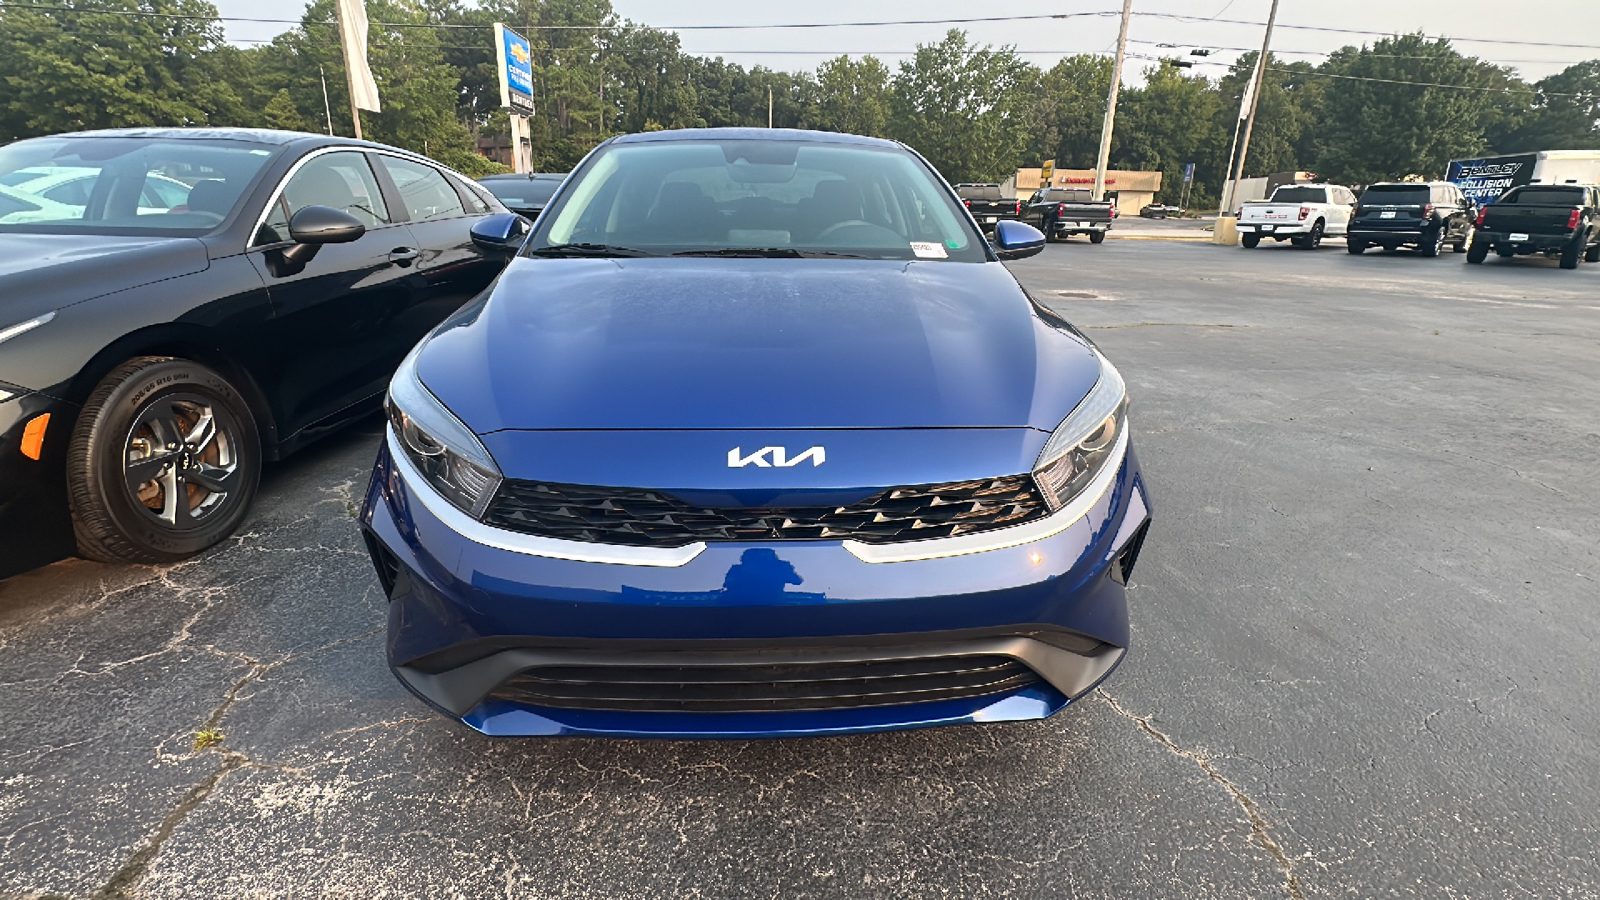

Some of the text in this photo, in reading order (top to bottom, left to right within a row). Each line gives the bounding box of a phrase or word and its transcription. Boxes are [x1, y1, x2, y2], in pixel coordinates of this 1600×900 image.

[1460, 178, 1513, 189] COLLISION
[1464, 188, 1503, 197] CENTER
[156, 376, 172, 386] R16
[727, 445, 826, 468] KIA
